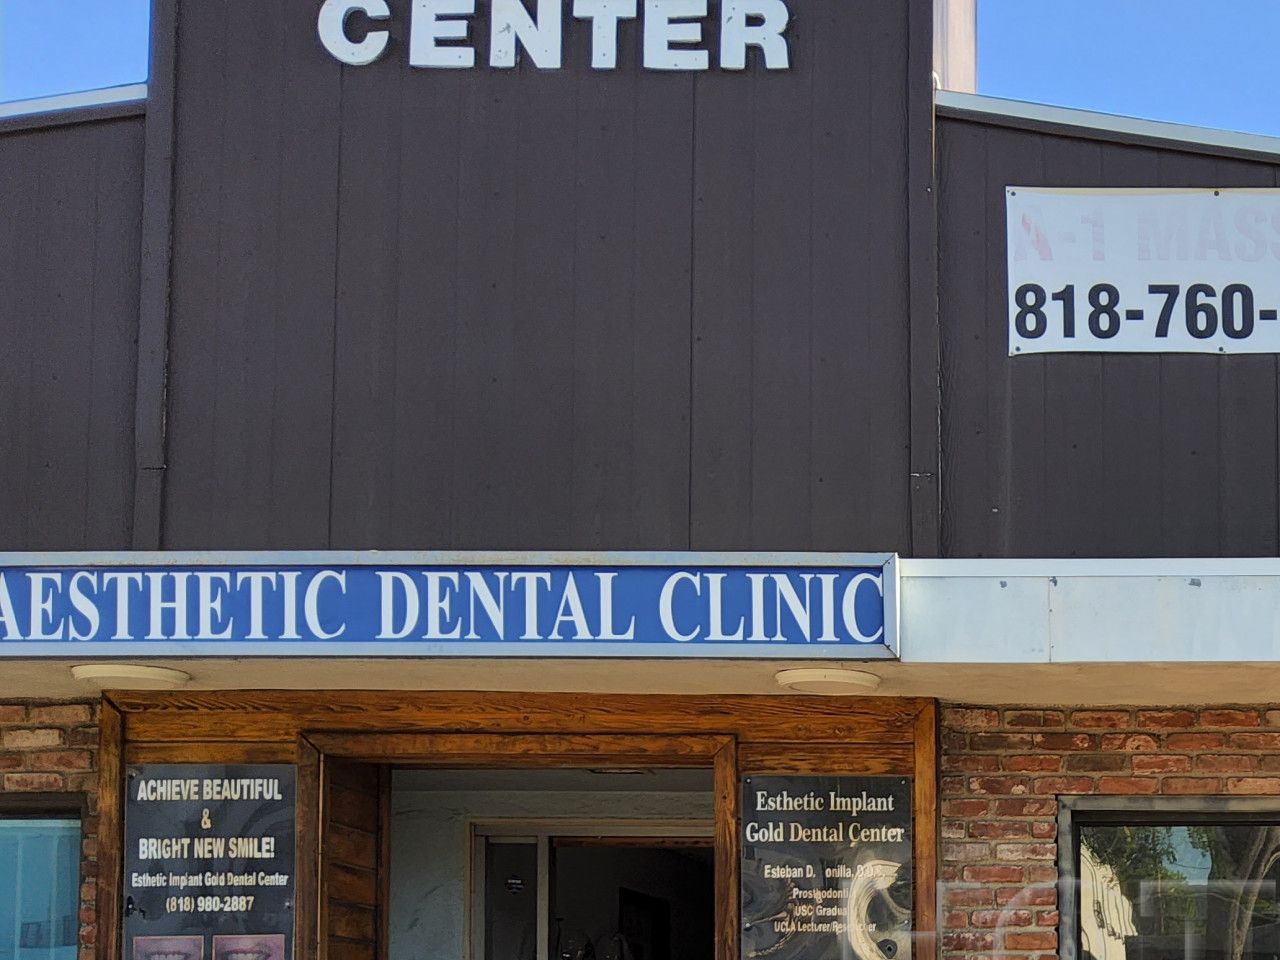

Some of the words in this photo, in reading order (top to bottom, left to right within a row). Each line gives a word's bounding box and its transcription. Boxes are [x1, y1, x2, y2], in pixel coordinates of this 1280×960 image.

[318, 0, 789, 70] CENTER
[375, 571, 635, 641] DENTAL
[659, 571, 883, 642] CLINIC
[137, 779, 199, 801] ACHIEVE
[203, 778, 283, 800] BEAUTIFUL
[756, 790, 825, 811] Esthetic
[829, 791, 895, 817] Implant
[201, 808, 212, 829] &
[745, 821, 784, 842] Gold
[789, 822, 844, 842] Dental
[849, 822, 905, 842] Center
[139, 838, 191, 860] BRIGHT
[194, 837, 225, 859] NEW
[228, 836, 275, 859] SMILE!
[131, 872, 167, 887] Esthetic
[169, 872, 202, 890] Implant
[204, 871, 225, 887] Gold
[228, 871, 256, 886] Dental
[258, 871, 289, 886] Center
[764, 864, 804, 879] Esteban
[818, 864, 854, 879] onilla,
[166, 896, 195, 913] (818)
[197, 895, 255, 912] 980-2887
[795, 905, 814, 916] USC
